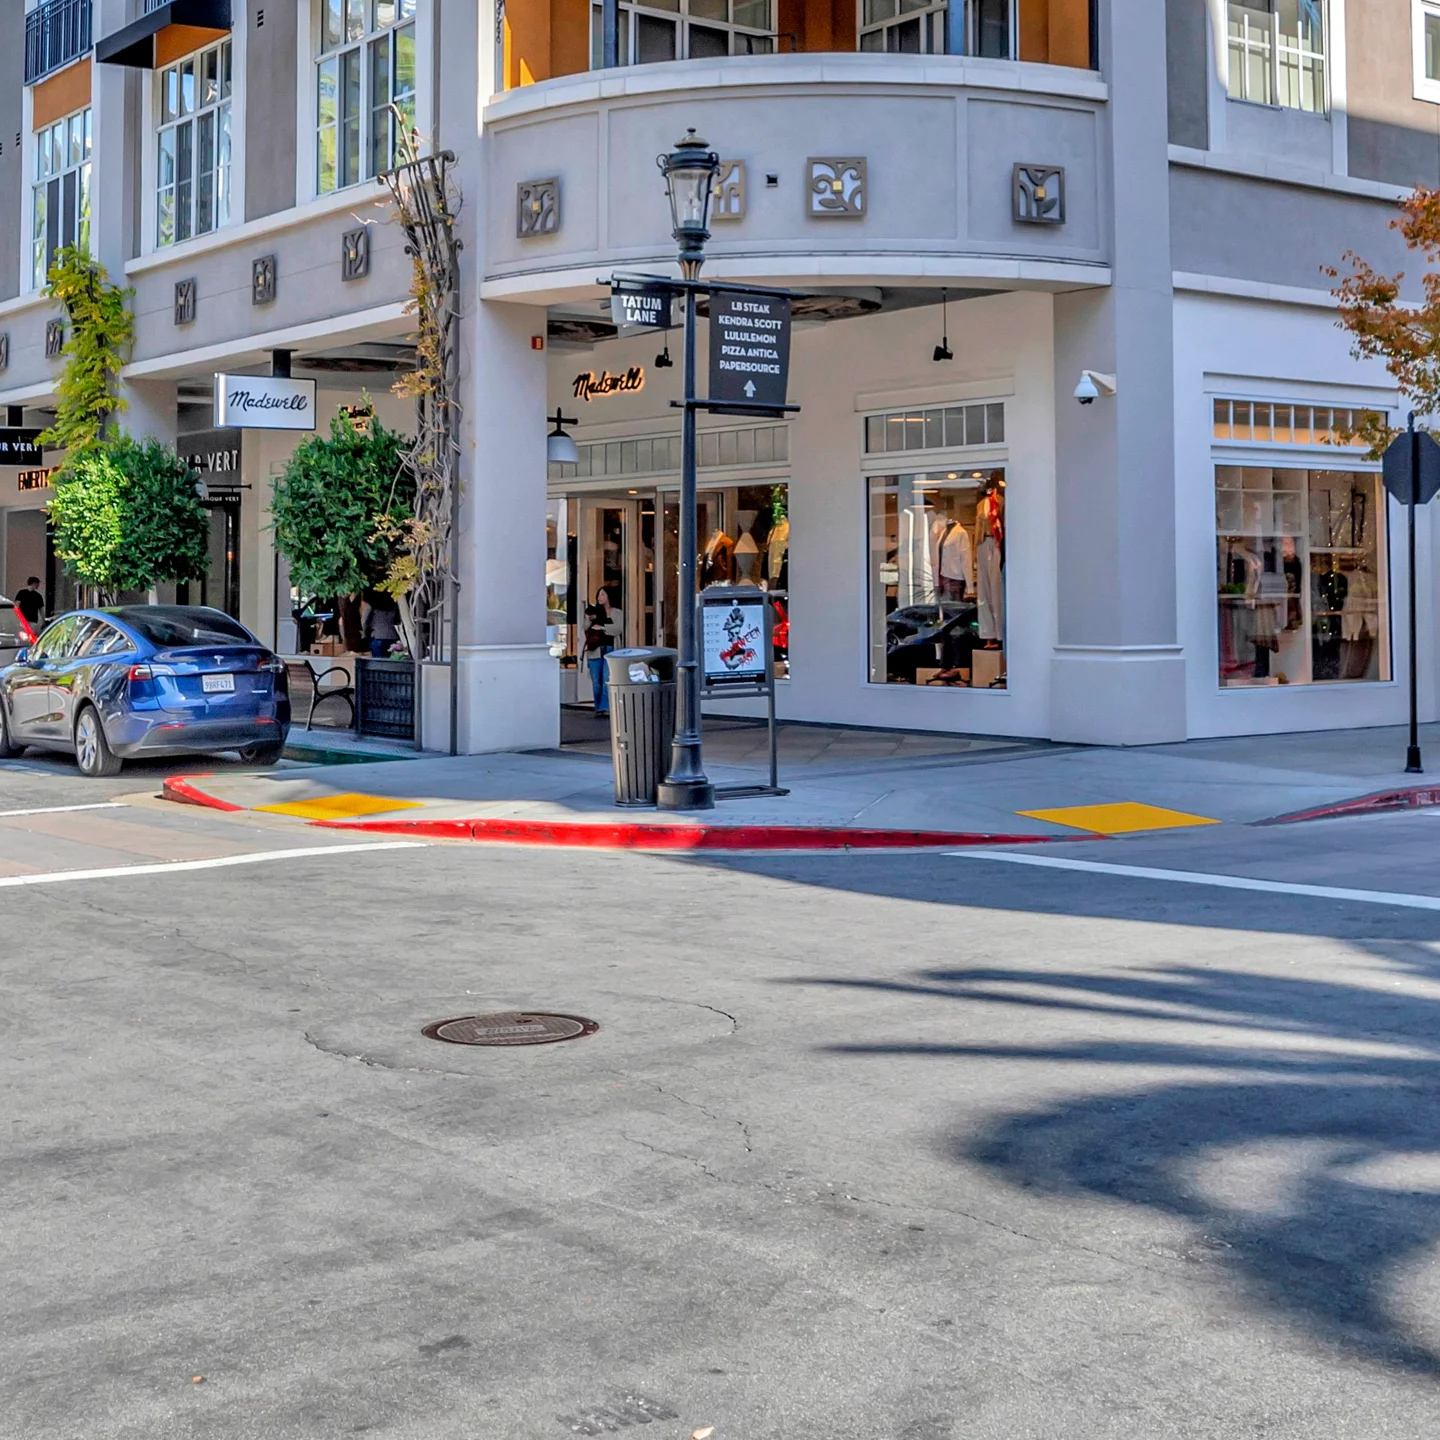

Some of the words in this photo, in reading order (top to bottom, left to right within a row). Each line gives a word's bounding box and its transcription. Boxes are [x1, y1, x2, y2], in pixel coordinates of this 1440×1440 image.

[621, 295, 662, 310] TATUM
[732, 301, 742, 311] LB
[744, 302, 770, 314] STEAK
[626, 308, 657, 323] LANE
[718, 315, 753, 327] KENDRA
[754, 318, 782, 330] SCOTT
[724, 330, 777, 344] LULULEMON
[721, 345, 746, 356] PIZZA
[747, 348, 779, 359] ANTICA
[719, 360, 780, 374] PAPERSOURCE
[572, 367, 642, 401] Madewell
[228, 391, 308, 412] Madewell
[207, 449, 238, 472] VERT
